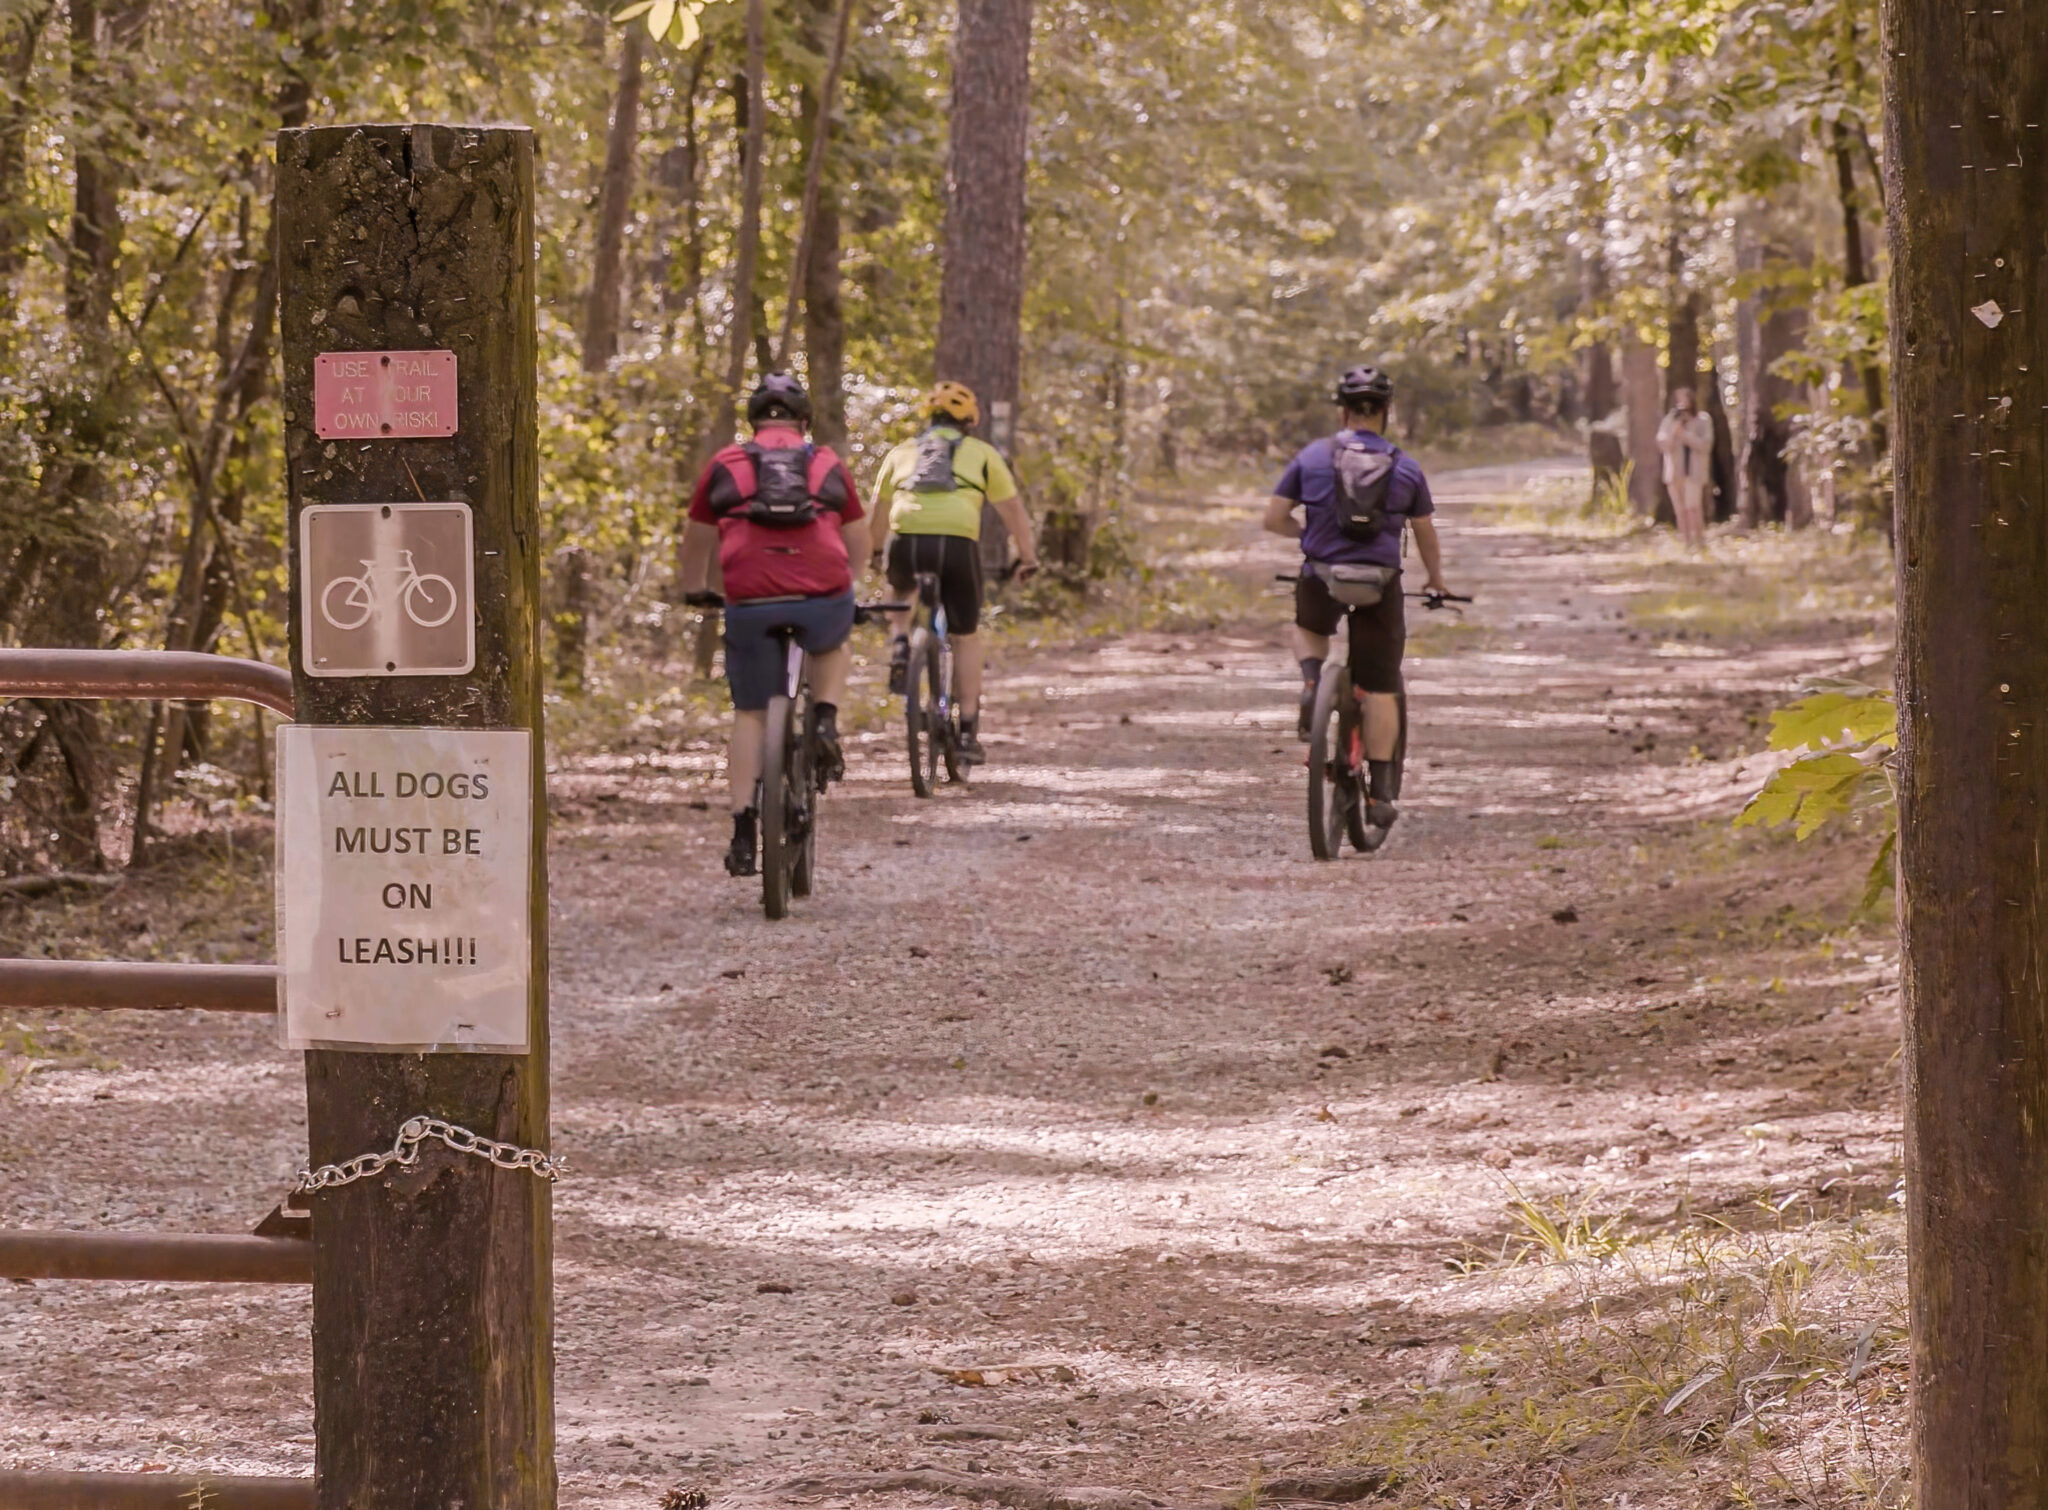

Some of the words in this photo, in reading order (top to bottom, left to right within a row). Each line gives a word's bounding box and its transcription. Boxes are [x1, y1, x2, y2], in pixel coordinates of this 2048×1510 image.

[332, 360, 369, 378] USE
[386, 360, 439, 377] RAIL
[341, 386, 365, 405] AT
[388, 385, 432, 404] OUR
[334, 412, 379, 430] OWN
[328, 771, 385, 798] ALL
[396, 772, 489, 800] DOGS
[335, 827, 432, 854] MUST
[443, 828, 481, 855] BE
[382, 882, 432, 909] ON
[338, 937, 477, 965] LEASH!!!
